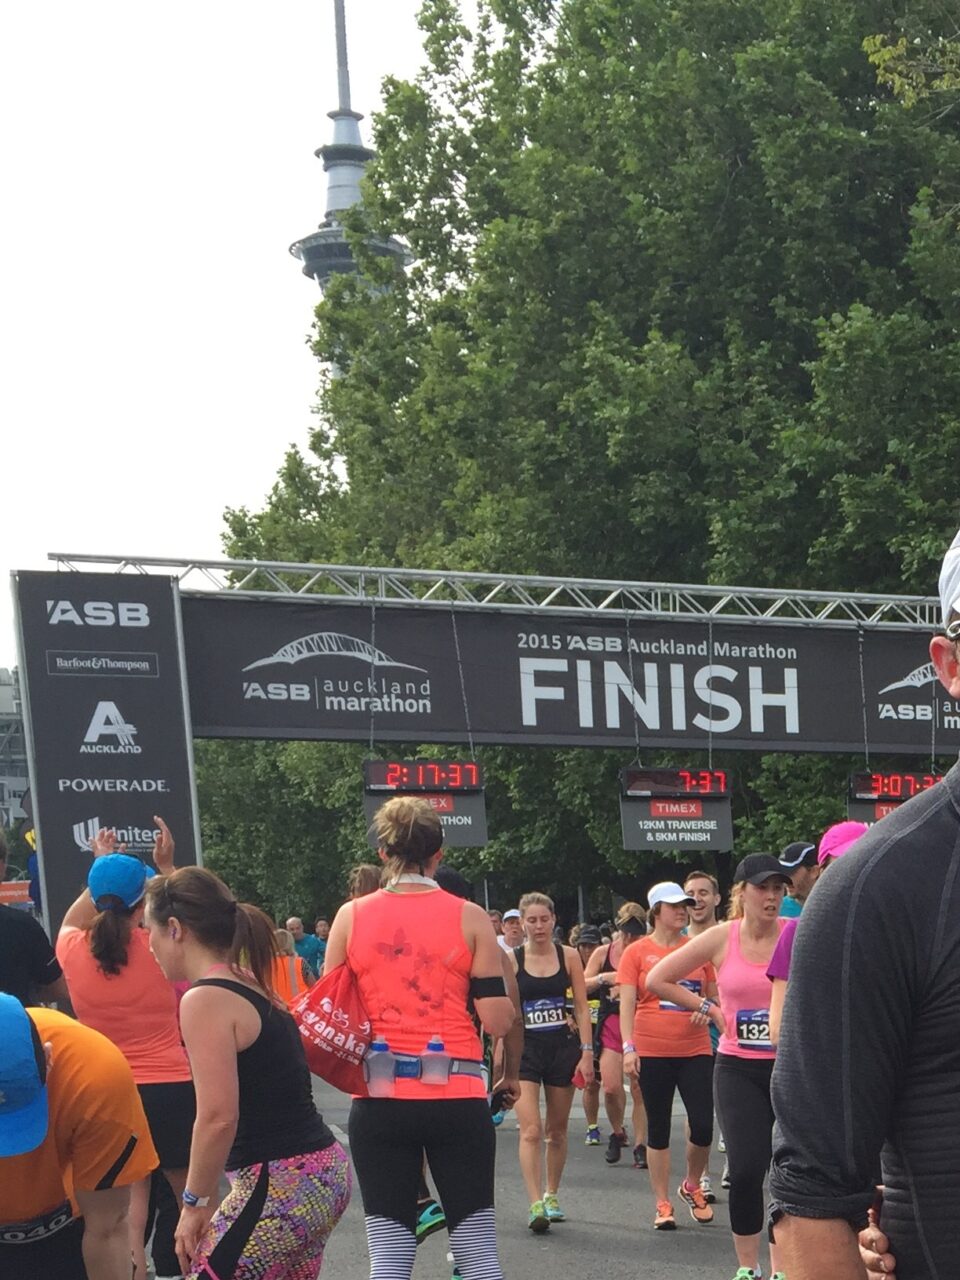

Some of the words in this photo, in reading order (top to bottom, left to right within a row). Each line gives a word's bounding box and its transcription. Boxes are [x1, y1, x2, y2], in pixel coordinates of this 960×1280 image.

[47, 600, 150, 627] ASB
[517, 633, 561, 650] 2015
[567, 636, 622, 652] ASB
[627, 639, 707, 656] Auckland
[713, 642, 797, 659] Marathon
[243, 682, 311, 701] ASB
[323, 678, 430, 695] auckland
[519, 657, 799, 734] FINISH
[325, 694, 431, 714] marathon
[879, 704, 933, 720] ASB
[80, 745, 142, 753] AUCKLAND
[656, 803, 696, 813] TIMEX
[638, 820, 664, 830] 12KM
[667, 820, 718, 830] TRAVERSE
[646, 832, 653, 842] &
[655, 832, 677, 842] 5KM
[679, 832, 711, 842] FINISH
[528, 1009, 563, 1024] 10131
